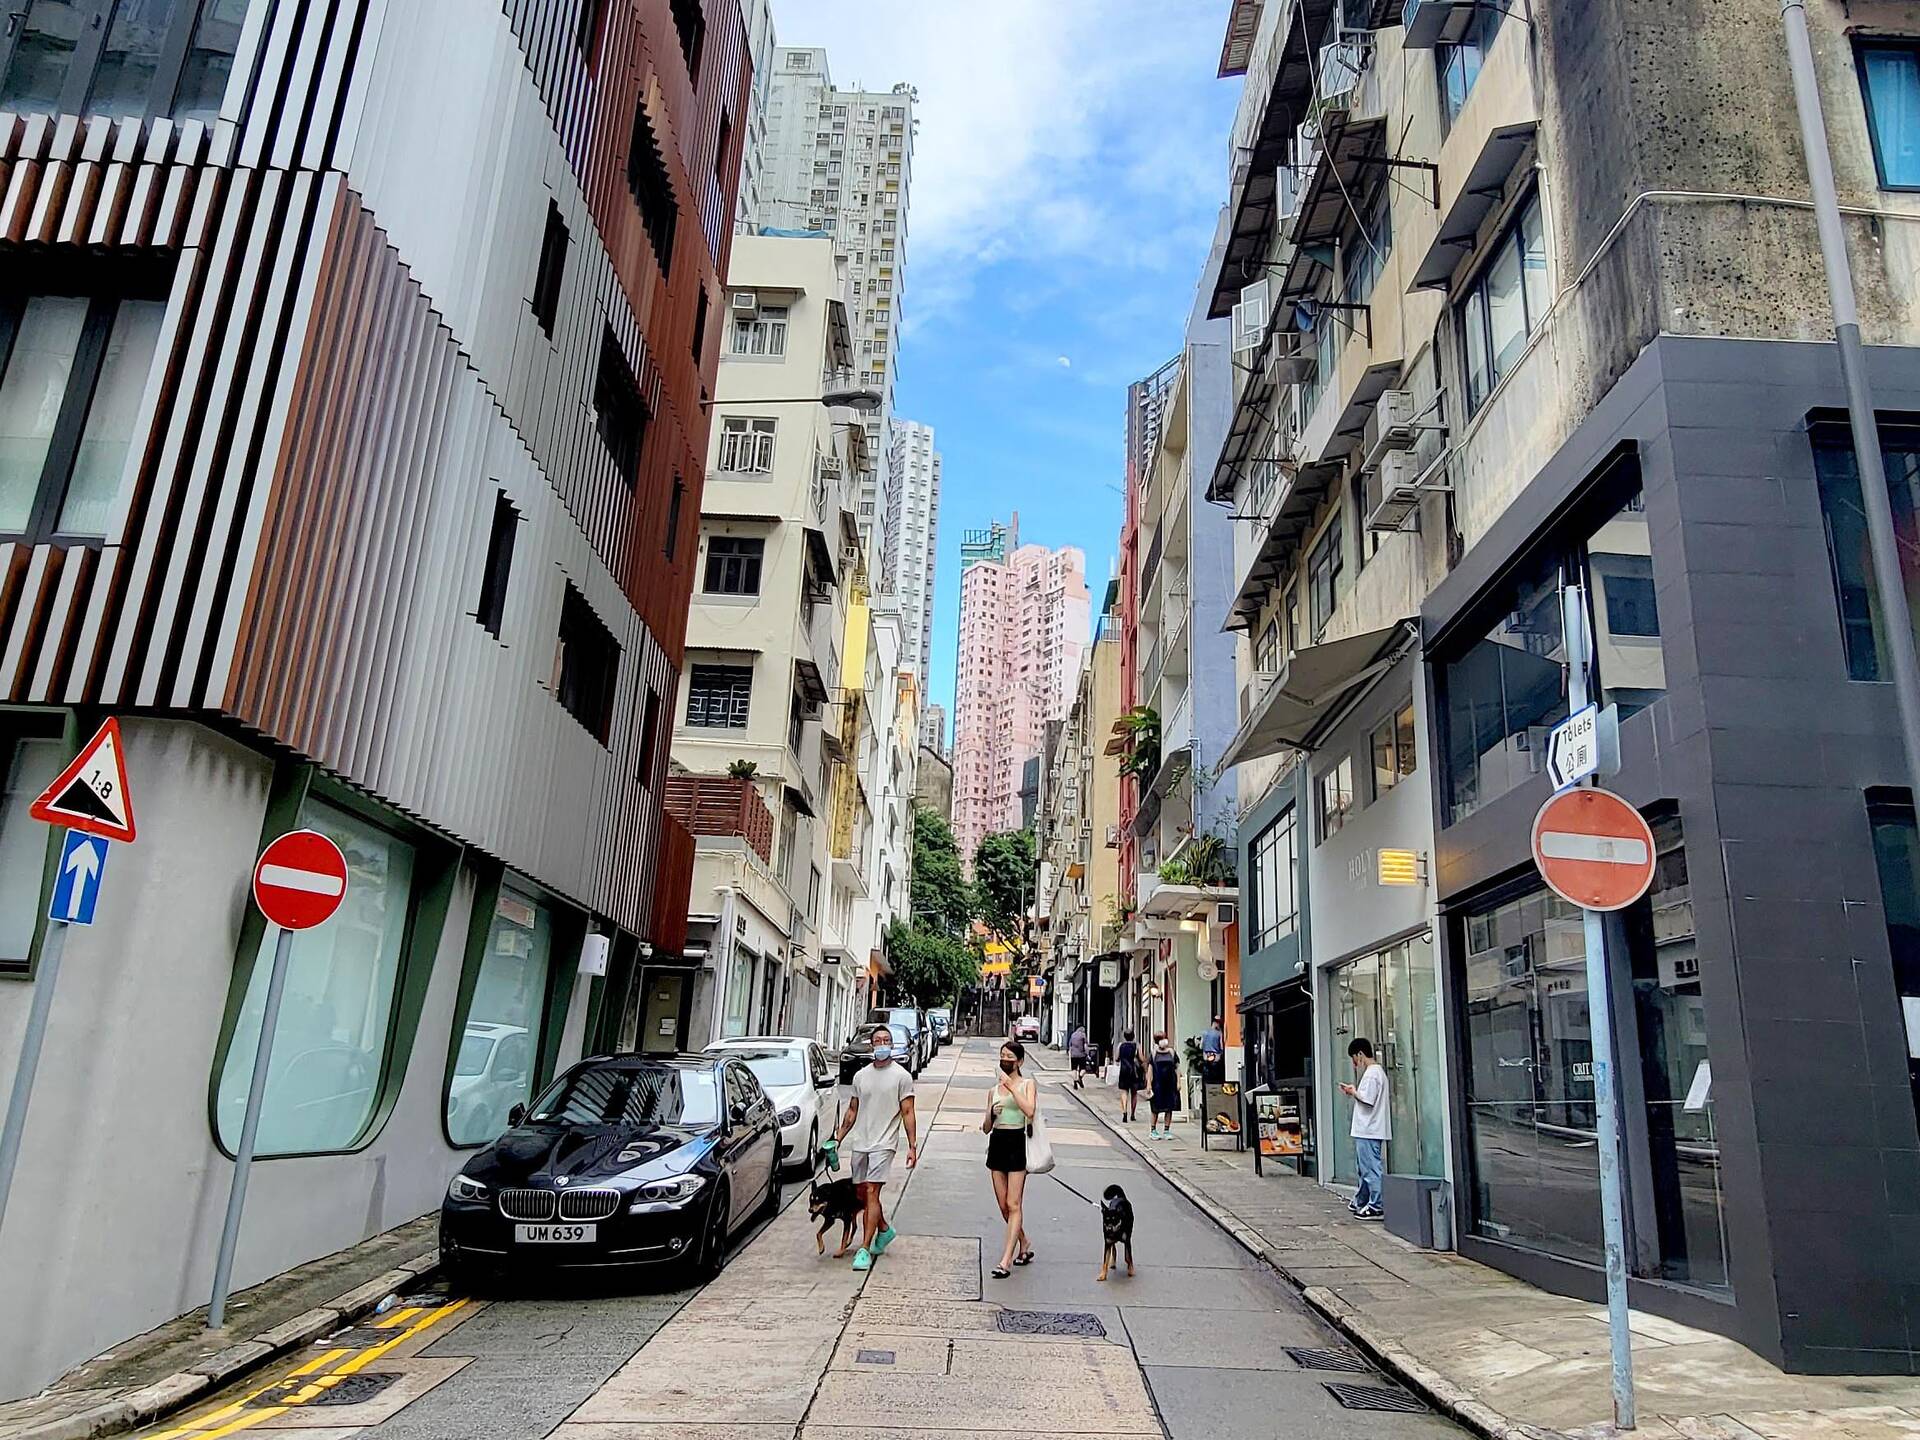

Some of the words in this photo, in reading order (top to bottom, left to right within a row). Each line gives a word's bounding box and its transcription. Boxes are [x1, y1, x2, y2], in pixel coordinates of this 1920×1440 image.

[1562, 718, 1592, 745] Tolets
[91, 770, 112, 799] 1:8
[527, 1226, 549, 1241] UM
[552, 1226, 584, 1241] 639
